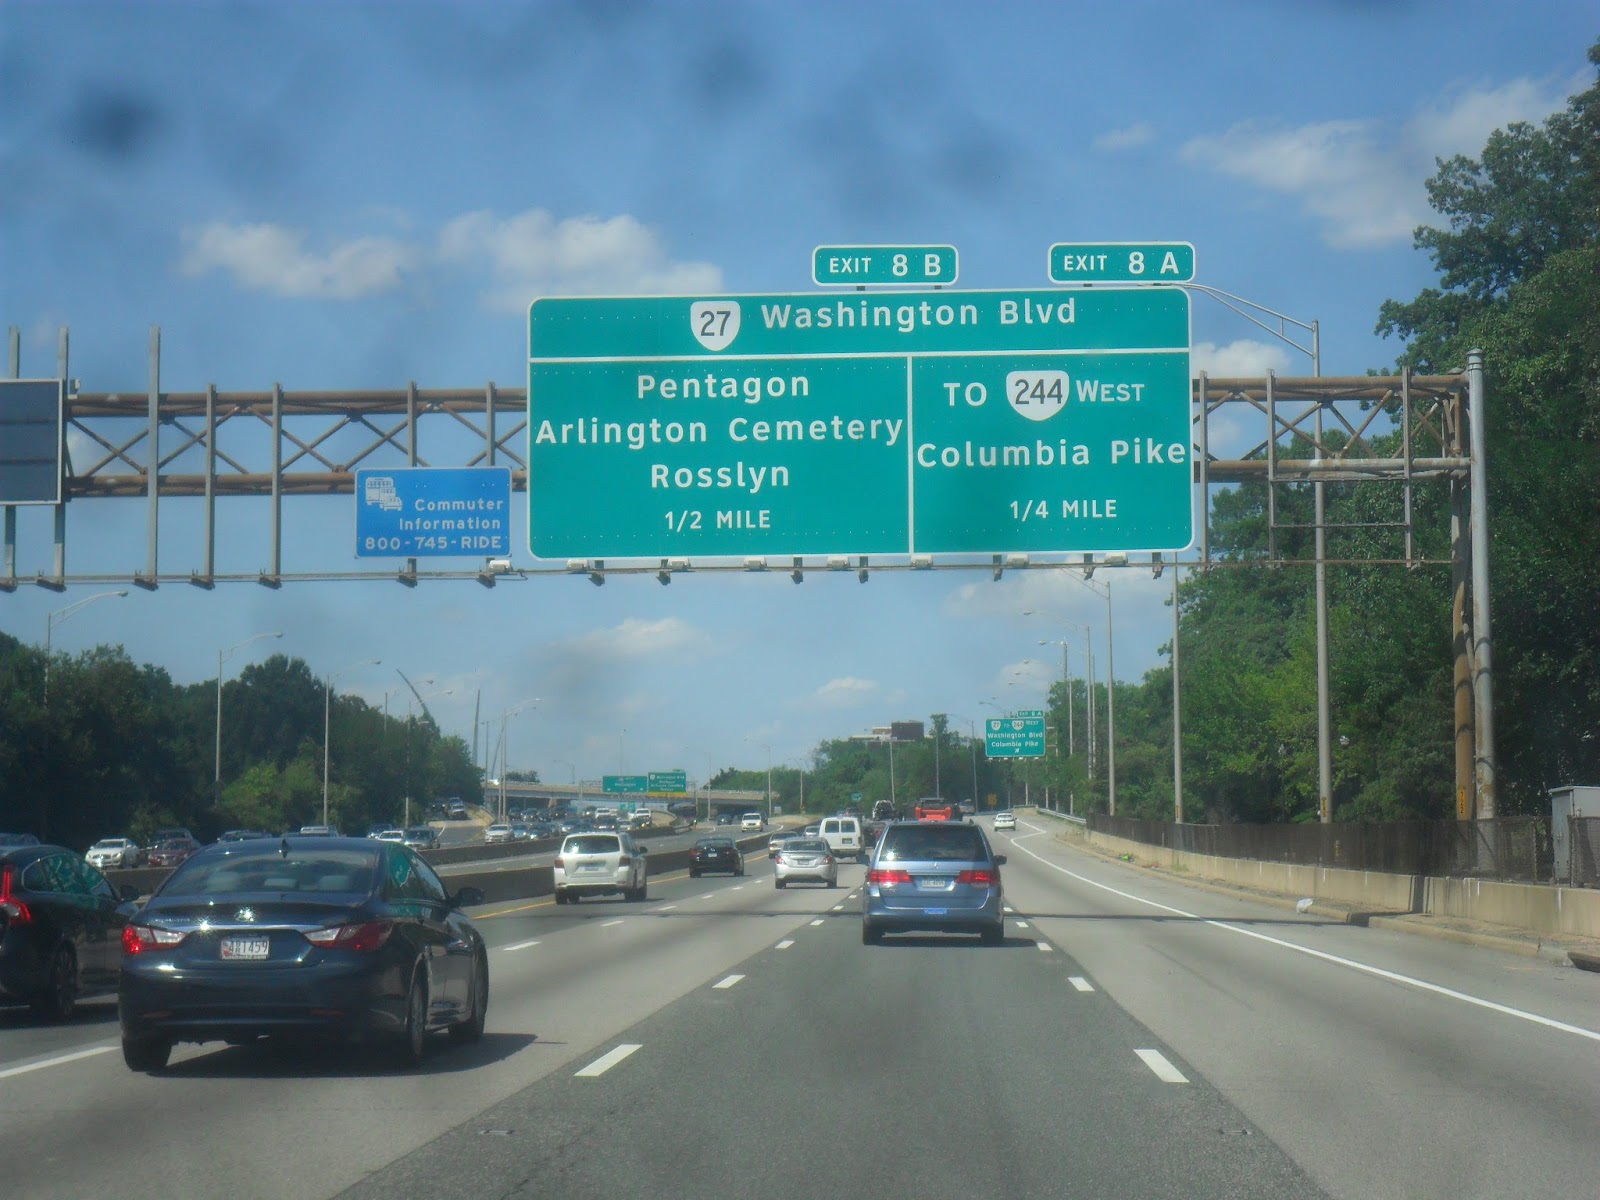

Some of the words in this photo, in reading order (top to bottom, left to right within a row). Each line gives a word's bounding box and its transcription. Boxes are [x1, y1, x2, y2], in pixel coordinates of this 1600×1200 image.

[829, 257, 872, 273] EXIT
[892, 254, 908, 276] 8
[924, 254, 941, 276] B
[1064, 254, 1107, 272] EXIT
[1128, 252, 1145, 274] 8
[1160, 252, 1180, 274] A
[700, 310, 731, 337] 27
[761, 300, 978, 333] Washington
[1000, 298, 1075, 325] Blvd
[637, 374, 809, 404] Pentagon
[943, 382, 987, 407] TO
[1014, 378, 1063, 405] 244
[1076, 380, 1145, 402] WEST
[535, 417, 707, 450] Arlington
[728, 416, 903, 447] Cemetery
[917, 440, 1090, 467] Columbia
[1111, 437, 1185, 464] Pike
[651, 461, 789, 493] Rosslyn
[415, 499, 503, 511] Commuter
[1010, 500, 1049, 521] 1/4
[1062, 499, 1117, 518] MILE
[400, 517, 501, 530] Information
[665, 510, 702, 532] 1/2
[717, 510, 771, 529] MILE
